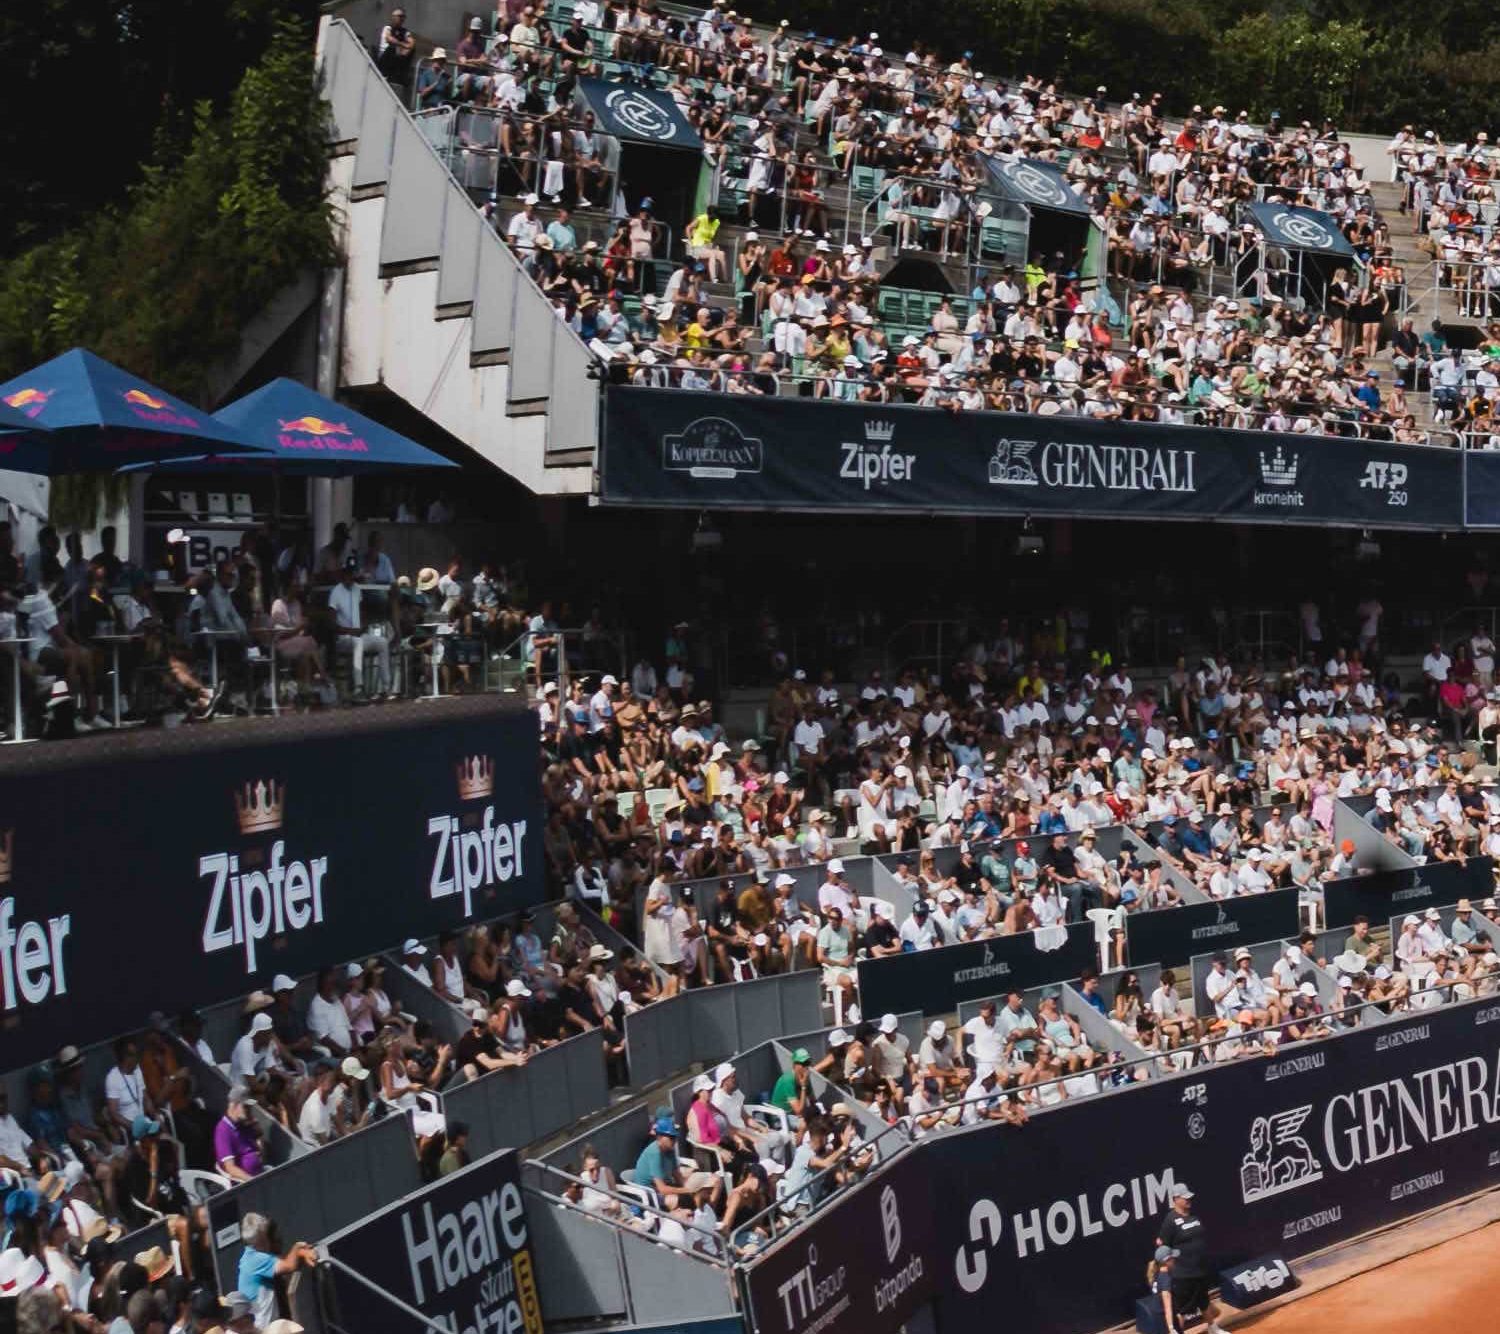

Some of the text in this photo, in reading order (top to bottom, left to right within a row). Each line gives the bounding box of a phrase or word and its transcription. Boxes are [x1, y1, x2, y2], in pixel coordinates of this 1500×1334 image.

[839, 442, 916, 490] Zipfer
[1041, 442, 1196, 492] GENERALI
[1358, 461, 1408, 490] ATP
[1254, 490, 1304, 507] kronehit
[1387, 490, 1408, 506] 250
[427, 805, 527, 917] Zipfer
[199, 840, 328, 973] Zipfer
[1013, 1167, 1176, 1259] HOLCIM
[401, 1181, 528, 1306] Haare
[873, 1253, 924, 1314] bitpanda
[1232, 1258, 1291, 1293] Tirol
